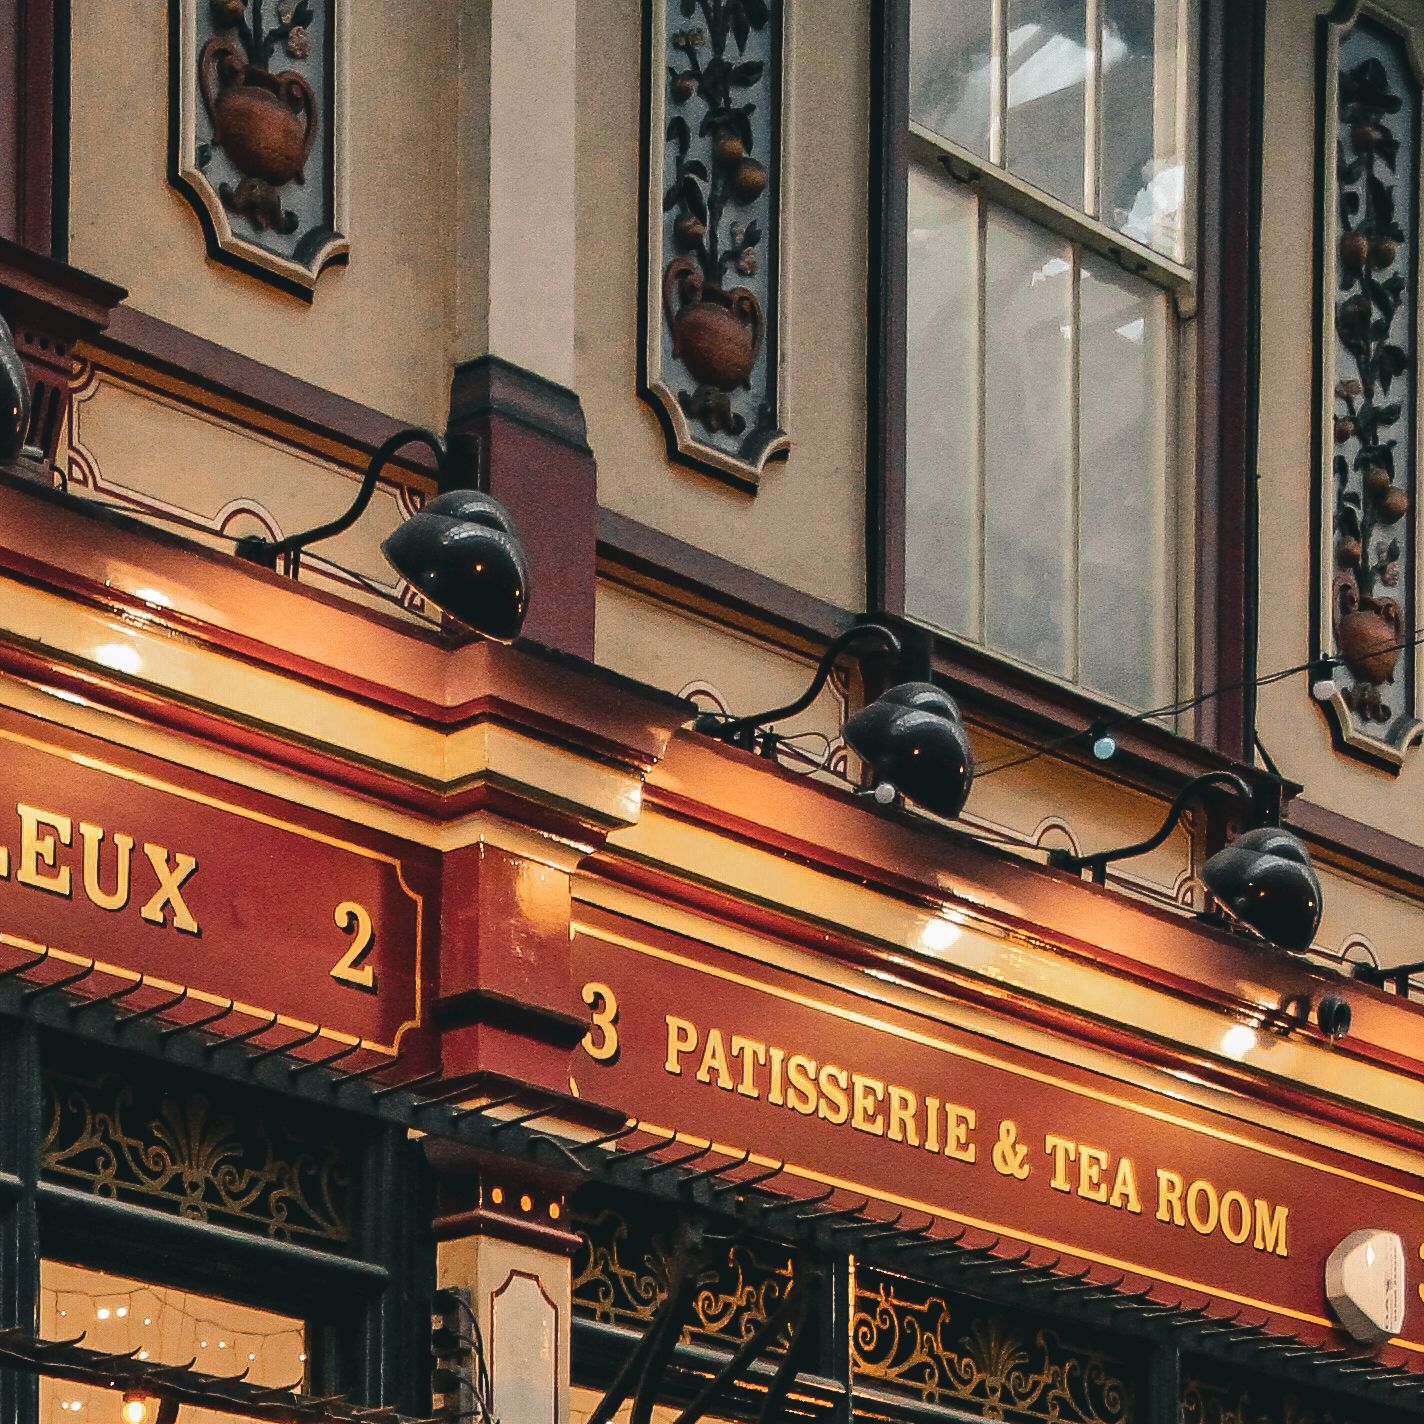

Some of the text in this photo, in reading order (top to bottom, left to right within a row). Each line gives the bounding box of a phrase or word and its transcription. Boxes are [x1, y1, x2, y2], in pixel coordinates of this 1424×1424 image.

[329, 901, 374, 987] 2
[581, 982, 619, 1061] 3
[664, 1014, 1290, 1257] PATISSERIE & TEA ROOM
